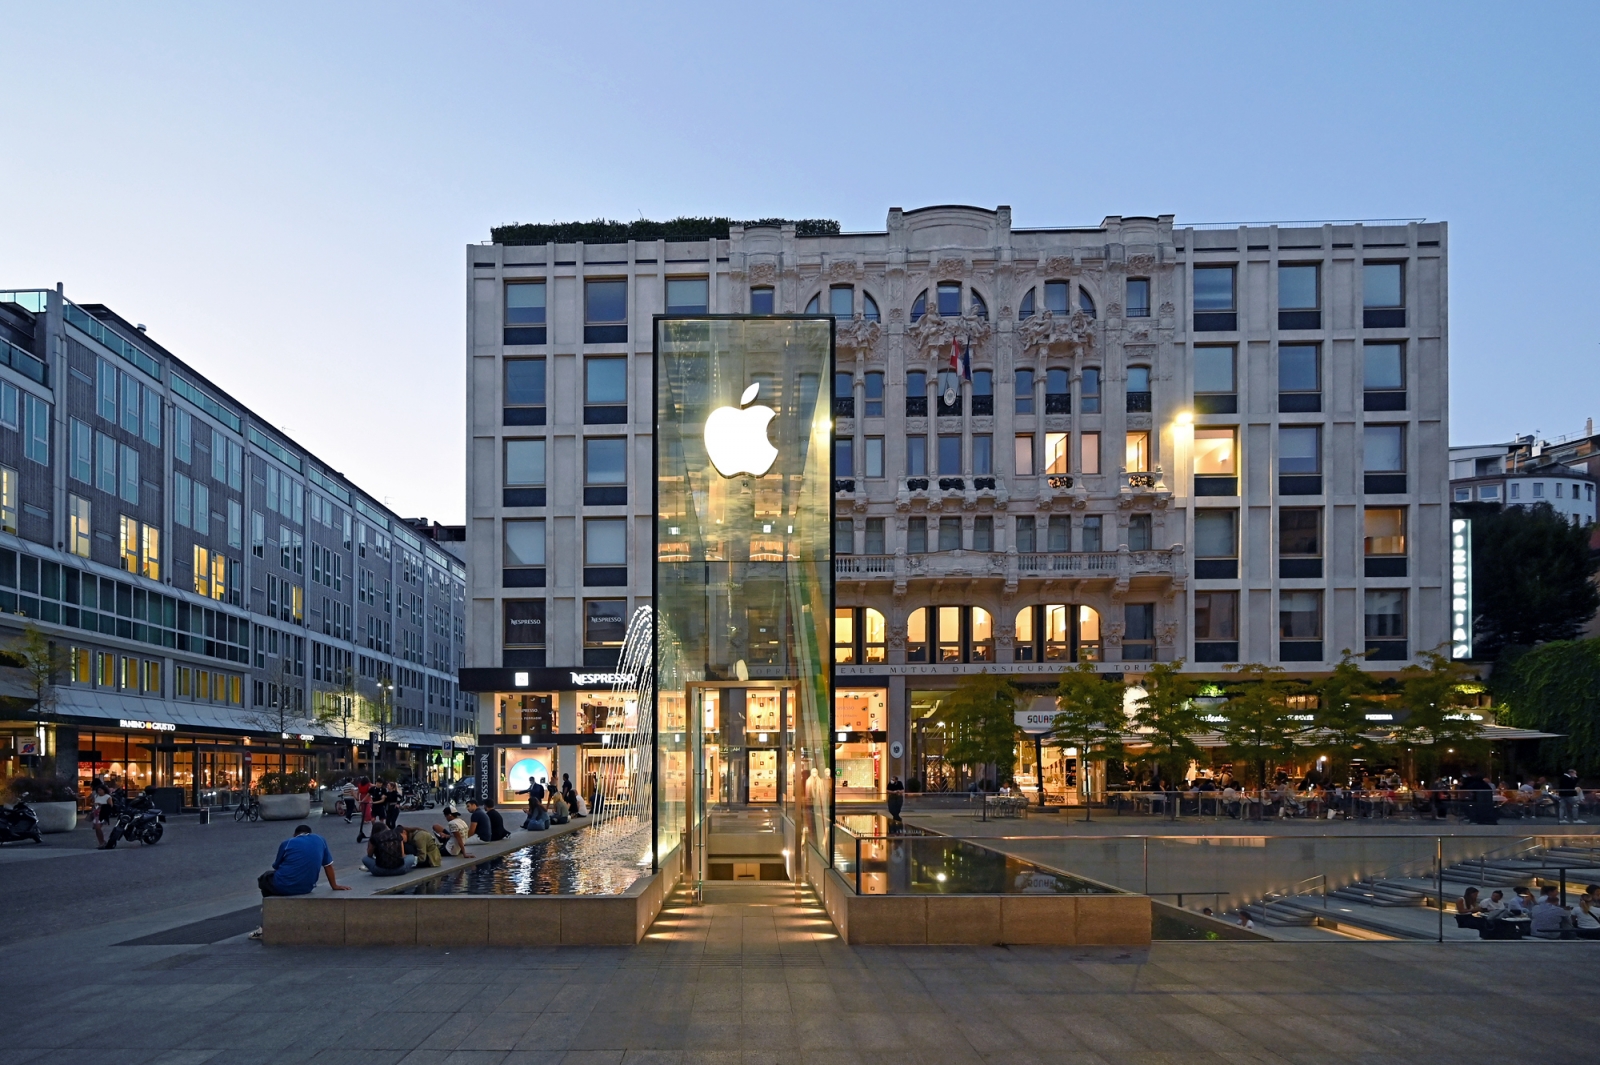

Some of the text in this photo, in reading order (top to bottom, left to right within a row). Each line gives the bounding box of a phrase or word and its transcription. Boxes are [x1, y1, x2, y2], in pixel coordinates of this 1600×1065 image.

[1452, 519, 1467, 641] PIZZERIA
[591, 616, 622, 624] NESPRESSO
[840, 666, 875, 674] EALE
[889, 666, 938, 674] MUTUA
[569, 671, 635, 686] NESPRESSO
[119, 719, 176, 731] PANINO GIUSTO
[480, 752, 490, 800] NESPRESSO
